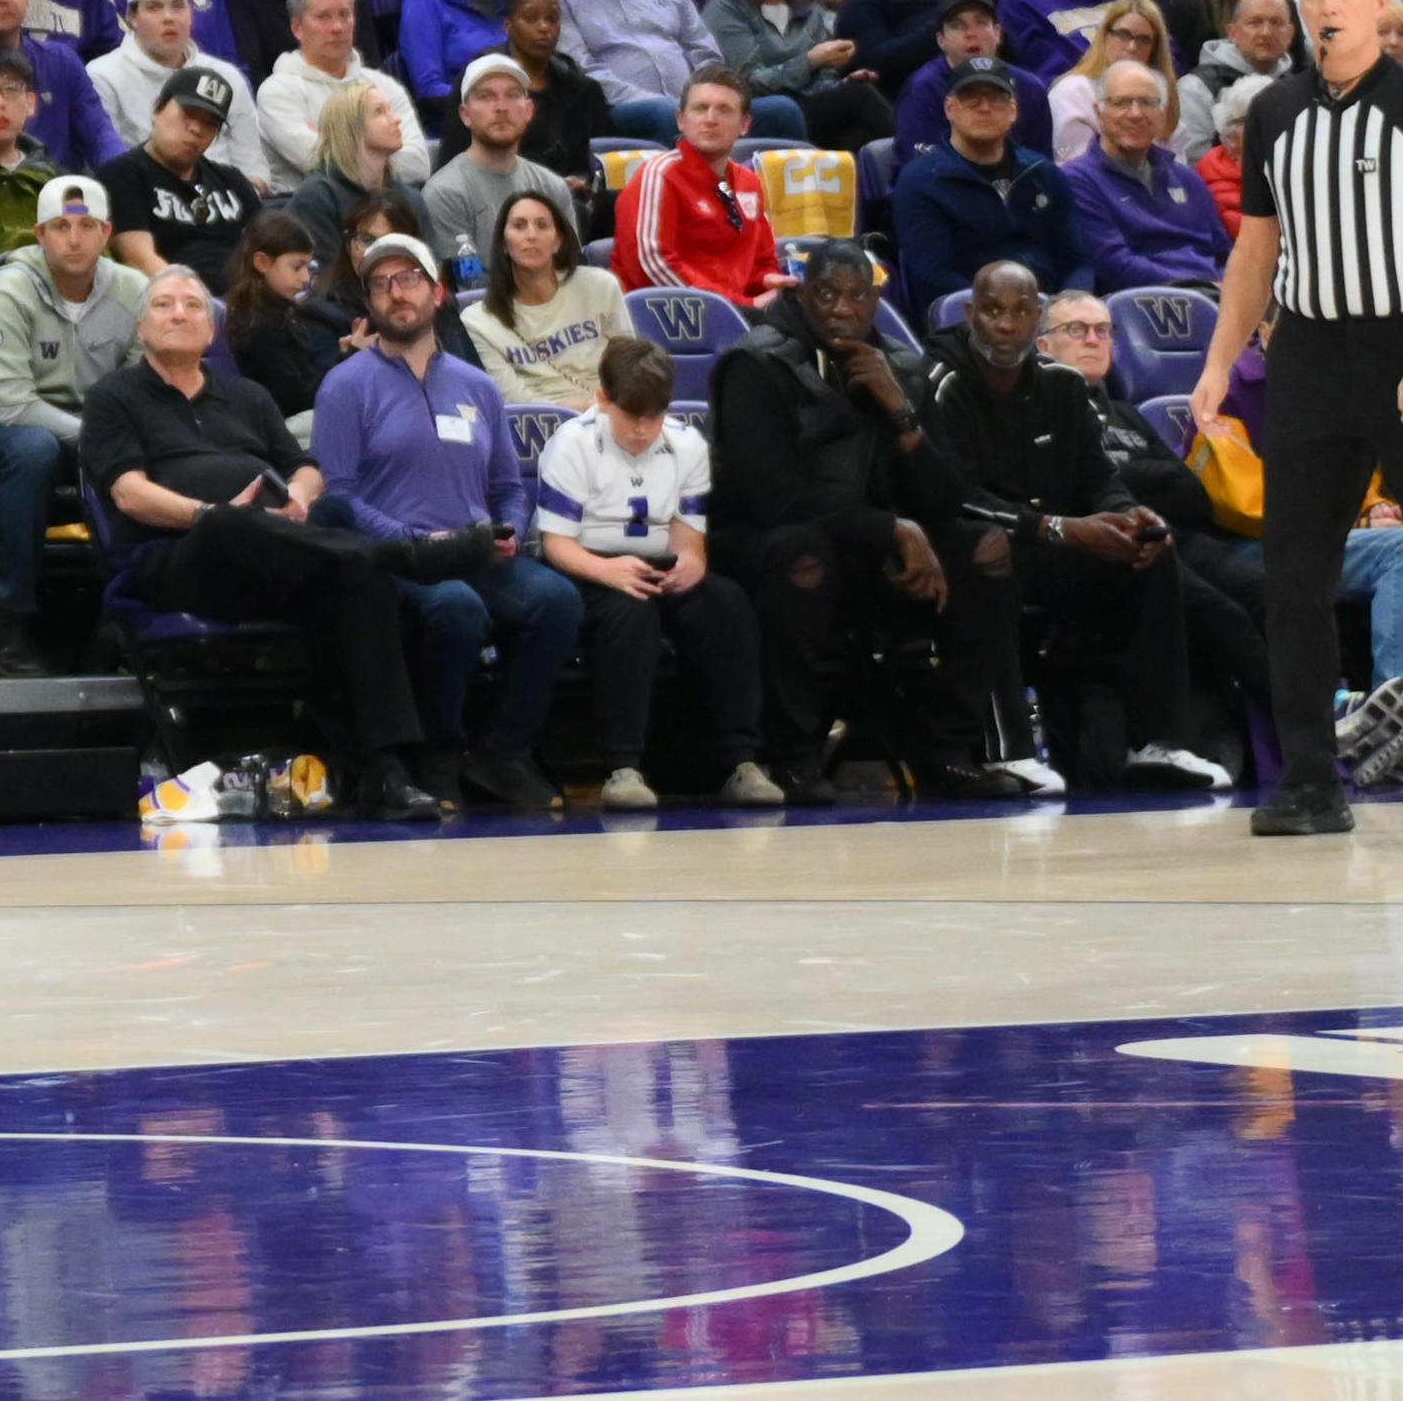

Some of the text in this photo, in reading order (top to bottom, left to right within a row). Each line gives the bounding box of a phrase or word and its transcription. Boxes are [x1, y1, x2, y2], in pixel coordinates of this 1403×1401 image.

[1355, 158, 1377, 174] TW
[645, 297, 704, 341] W
[1134, 296, 1192, 338] W
[39, 341, 60, 360] W
[505, 321, 600, 367] HUSKIES
[625, 496, 649, 537] 1
